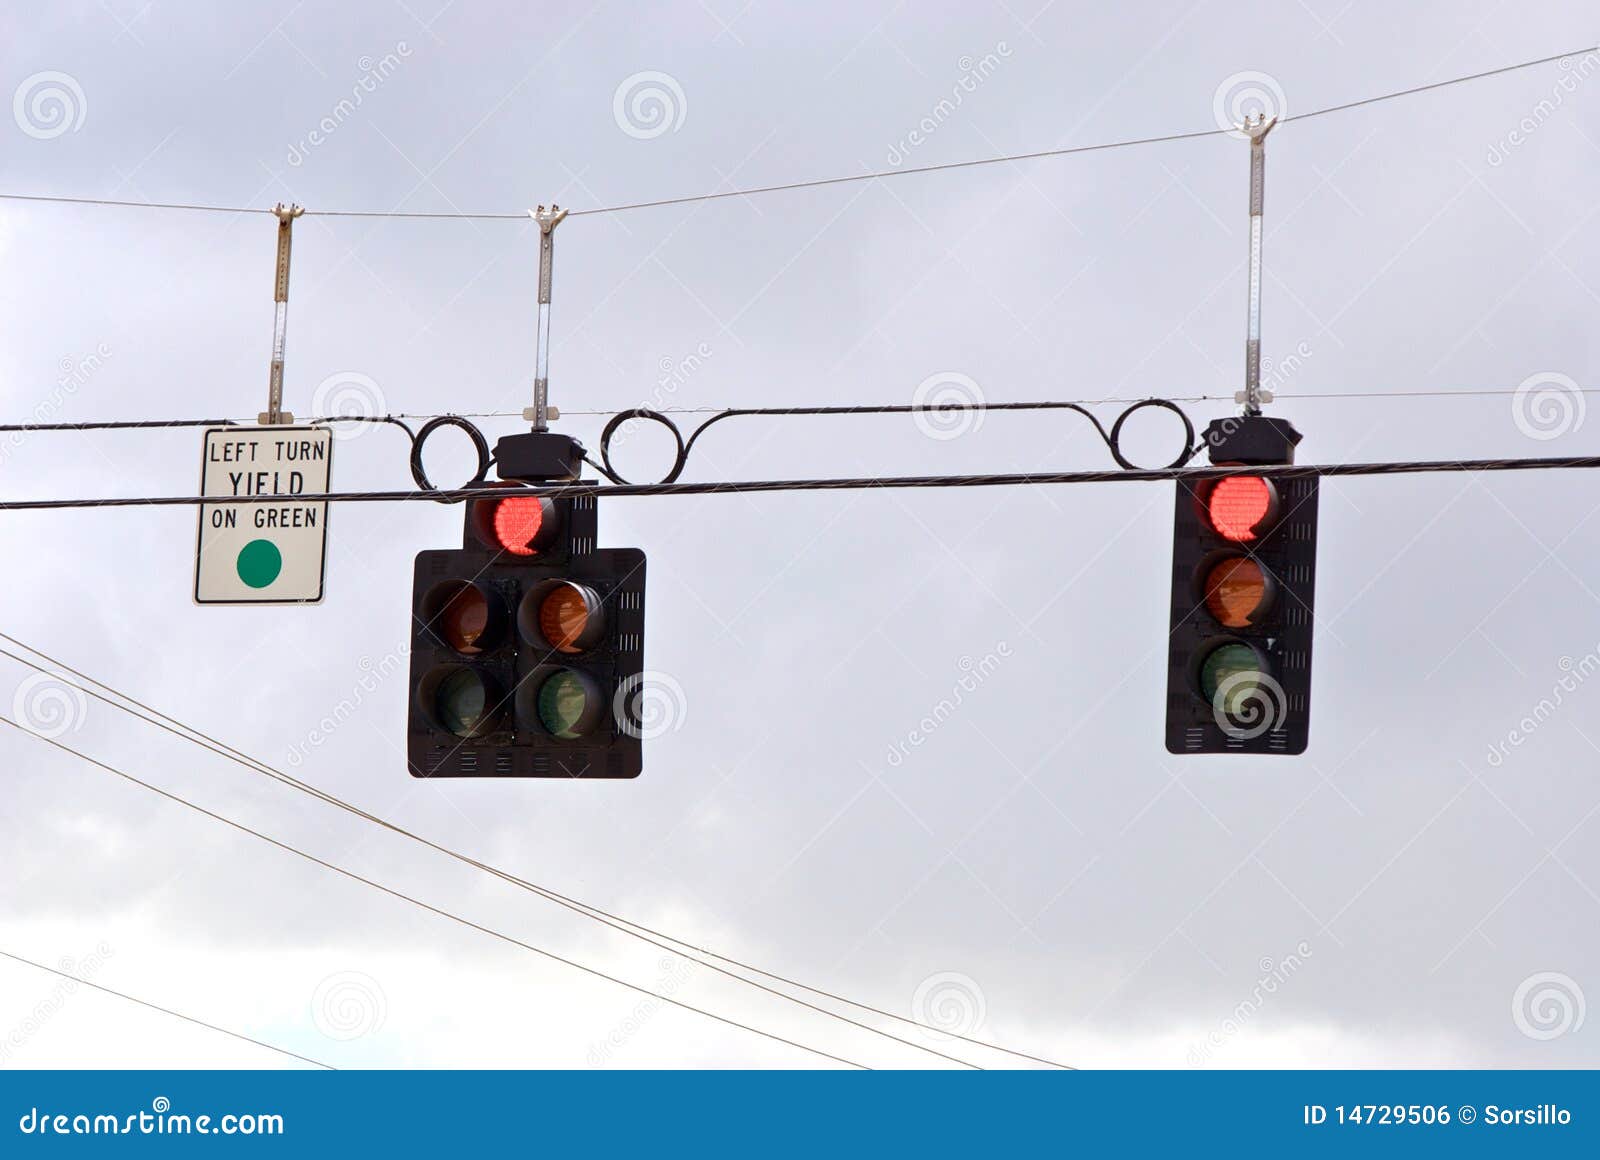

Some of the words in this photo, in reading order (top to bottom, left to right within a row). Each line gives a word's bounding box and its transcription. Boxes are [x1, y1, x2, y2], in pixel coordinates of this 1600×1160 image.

[210, 442, 259, 462] LEFT
[275, 441, 325, 461] TURN
[229, 471, 304, 496] YIELD
[211, 508, 237, 529] ON
[254, 508, 316, 528] GREEN
